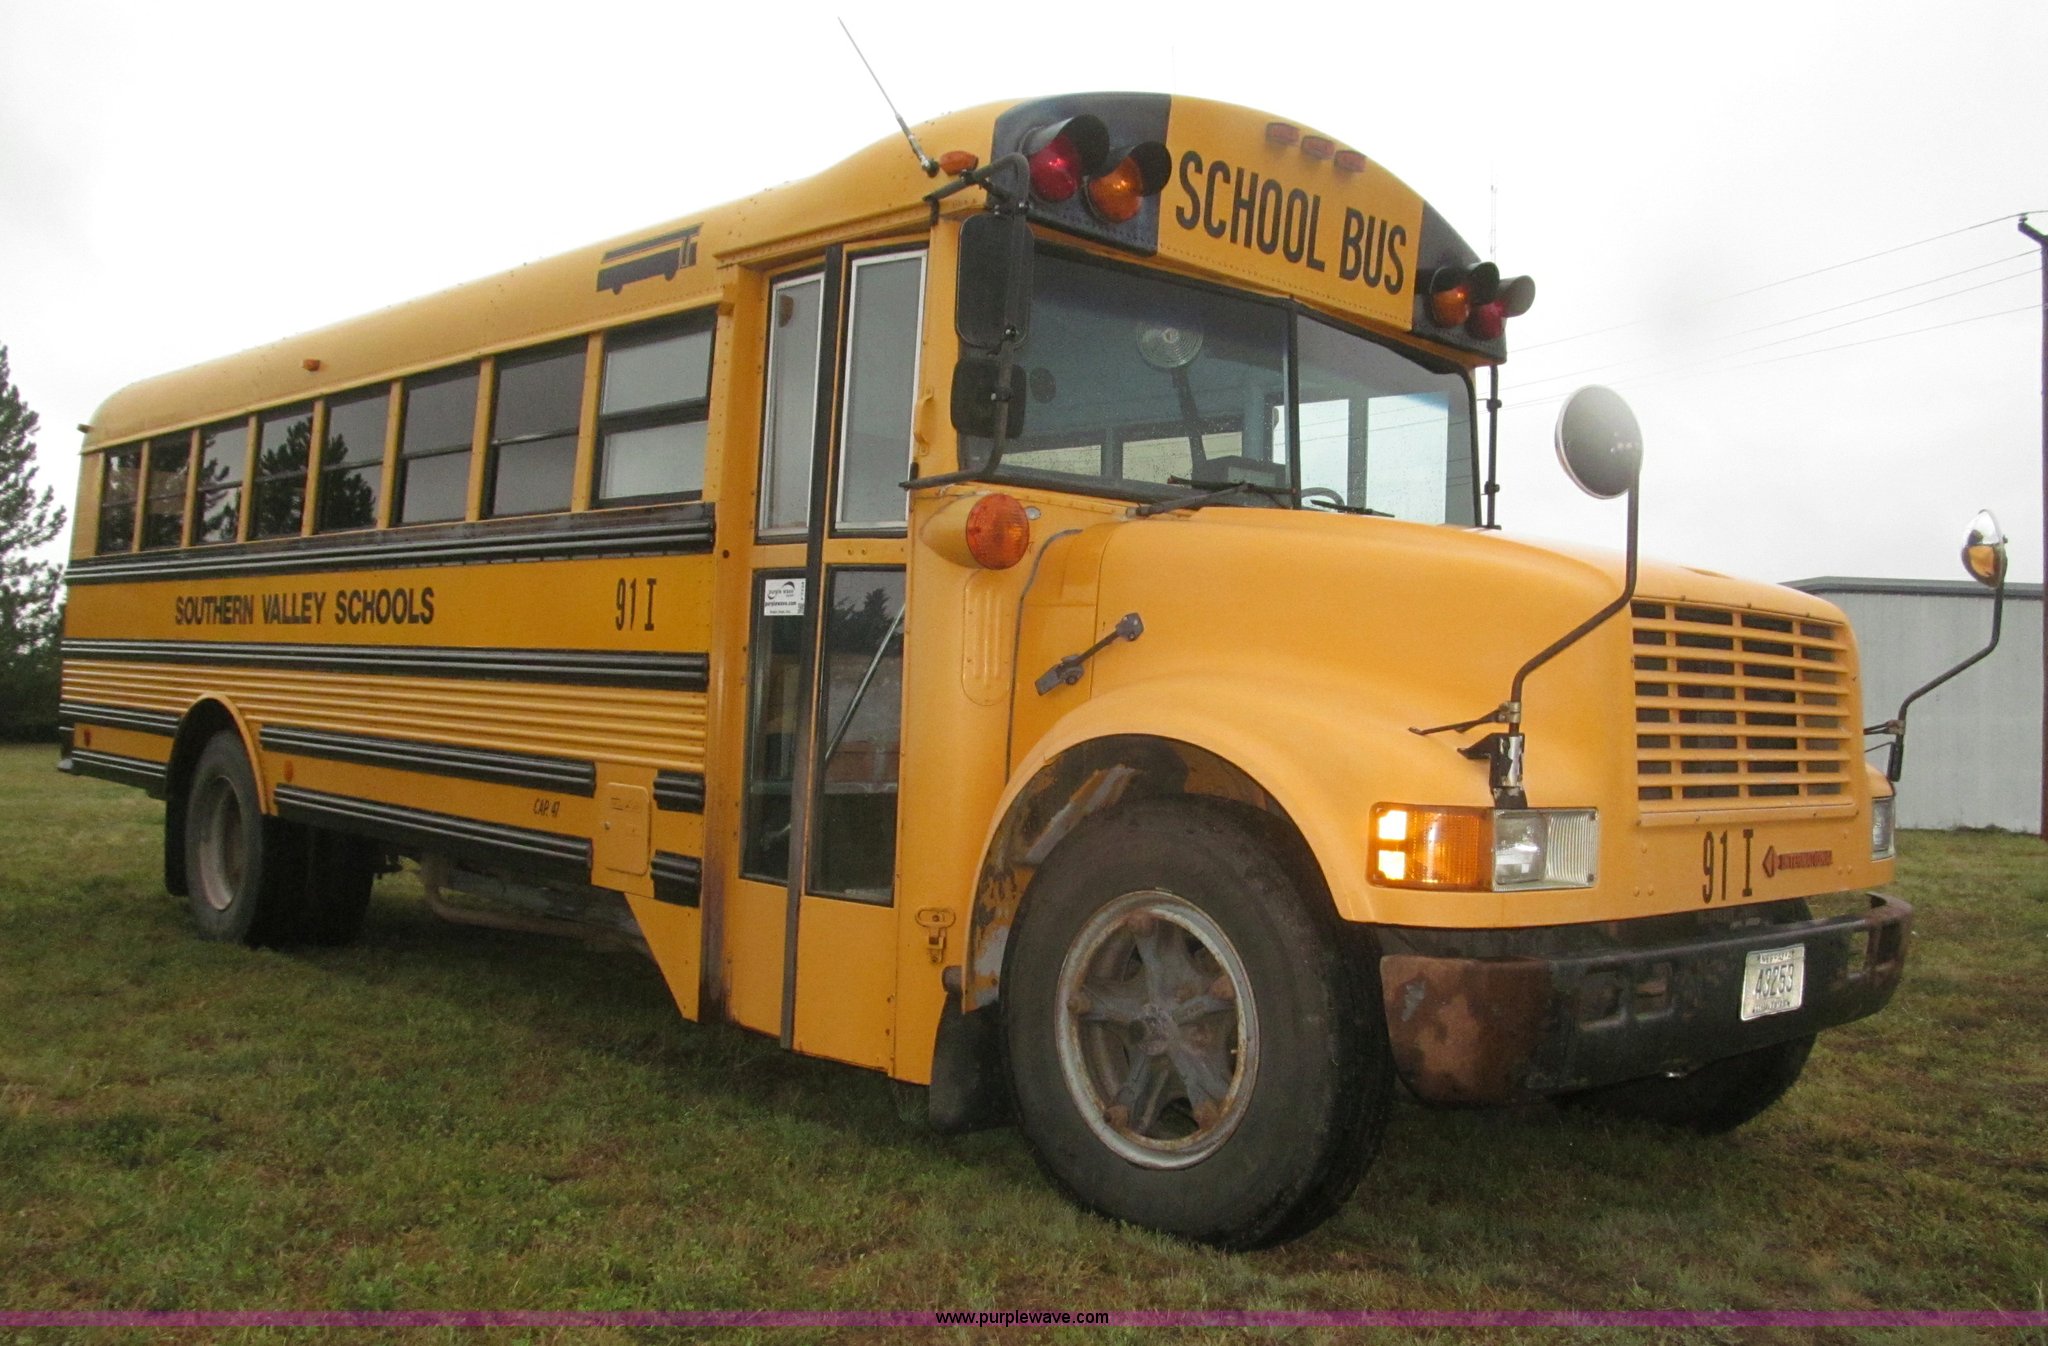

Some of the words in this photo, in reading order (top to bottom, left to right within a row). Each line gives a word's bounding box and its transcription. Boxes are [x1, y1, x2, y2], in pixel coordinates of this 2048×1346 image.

[1175, 150, 1325, 272] SCHOOL
[1339, 206, 1407, 295] BUS
[175, 595, 253, 626] SOUTHERN
[262, 591, 326, 625] VALLEY
[335, 586, 434, 625] SCHOOLS
